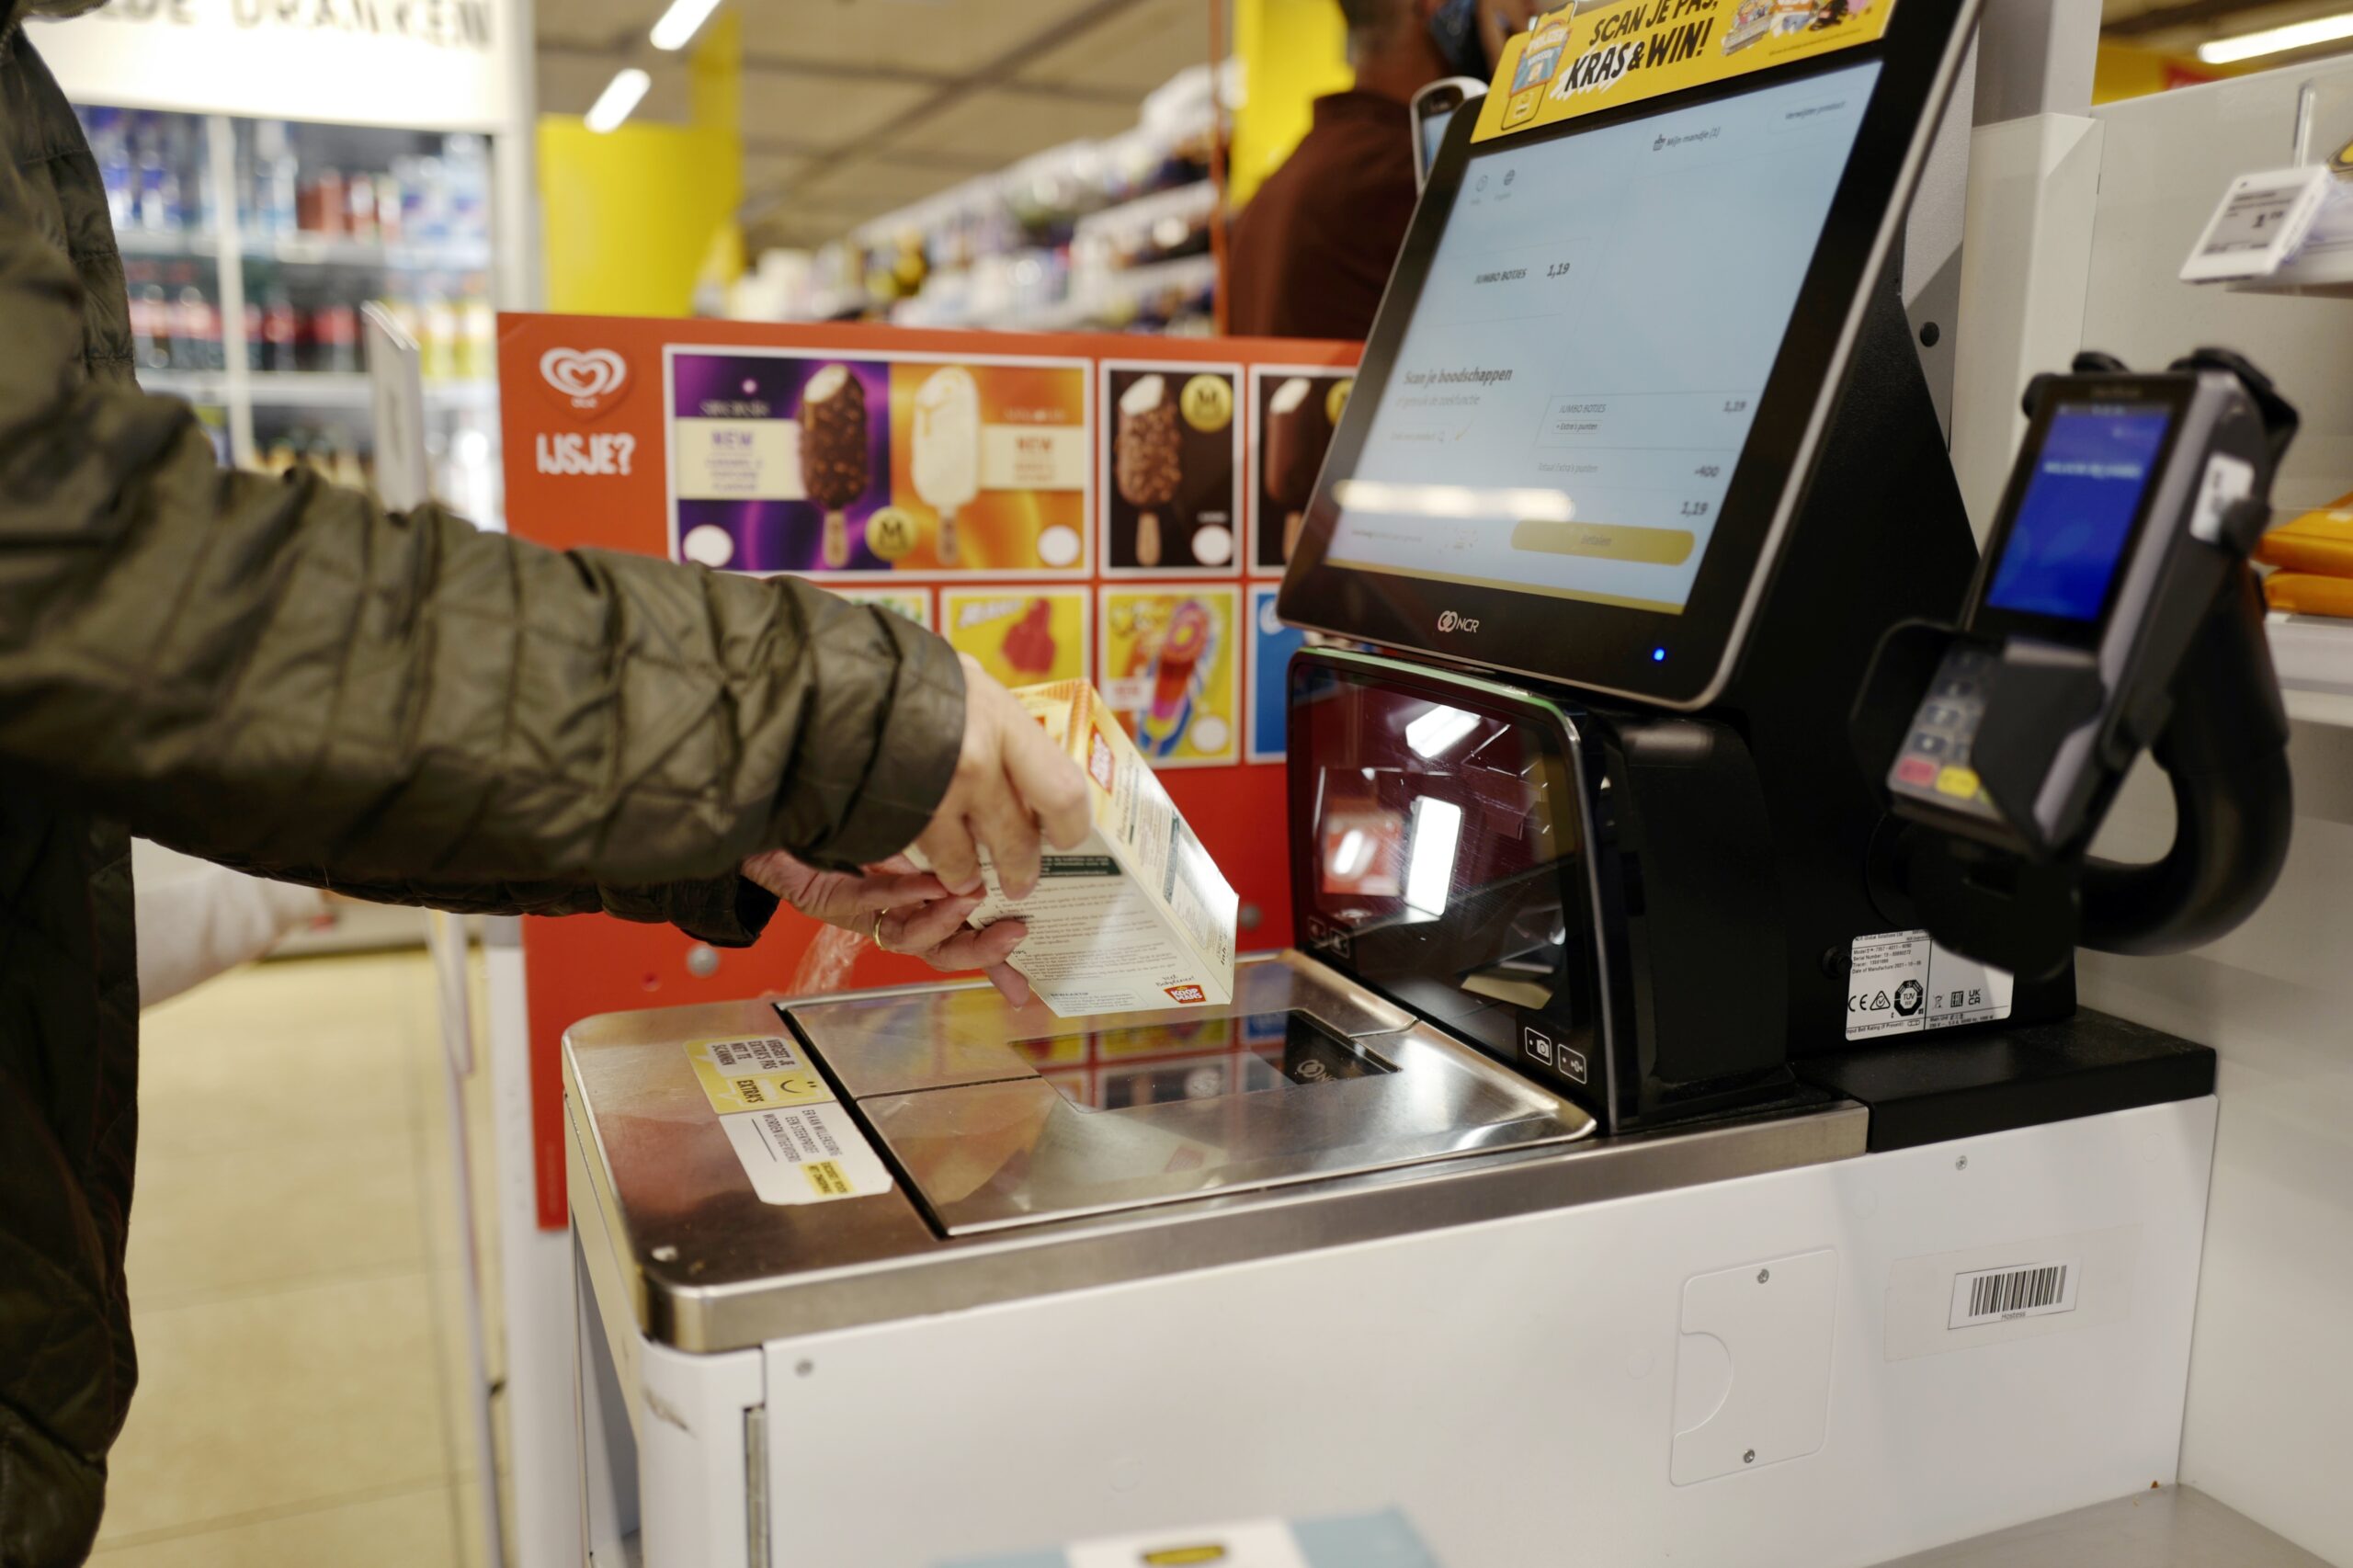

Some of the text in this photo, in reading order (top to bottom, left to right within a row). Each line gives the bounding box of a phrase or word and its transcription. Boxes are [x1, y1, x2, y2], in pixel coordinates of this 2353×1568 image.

[1589, 4, 1648, 46] SCAN
[1645, 0, 1671, 28] JE
[1547, 263, 1570, 278] 1,19
[1404, 367, 1514, 388] Scan je boodschappen
[1559, 404, 1583, 414] JUMBO
[1723, 401, 1746, 415] 1,19
[536, 432, 636, 476] IJSJE?
[1680, 502, 1709, 517] 1,19
[1456, 618, 1480, 633] NCR
[1969, 988, 1981, 997] UK
[1969, 997, 1981, 1006] CA
[730, 1042, 748, 1052] NIET
[747, 1040, 772, 1060] EXTRA'S
[766, 1039, 790, 1058] VERGEET
[712, 1044, 737, 1066] SCANNEN
[758, 1060, 779, 1070] PAS
[736, 1079, 765, 1103] EXTRA'S
[763, 1113, 784, 1134] WORDEN
[785, 1116, 801, 1126] EEN
[806, 1115, 823, 1126] KAN
